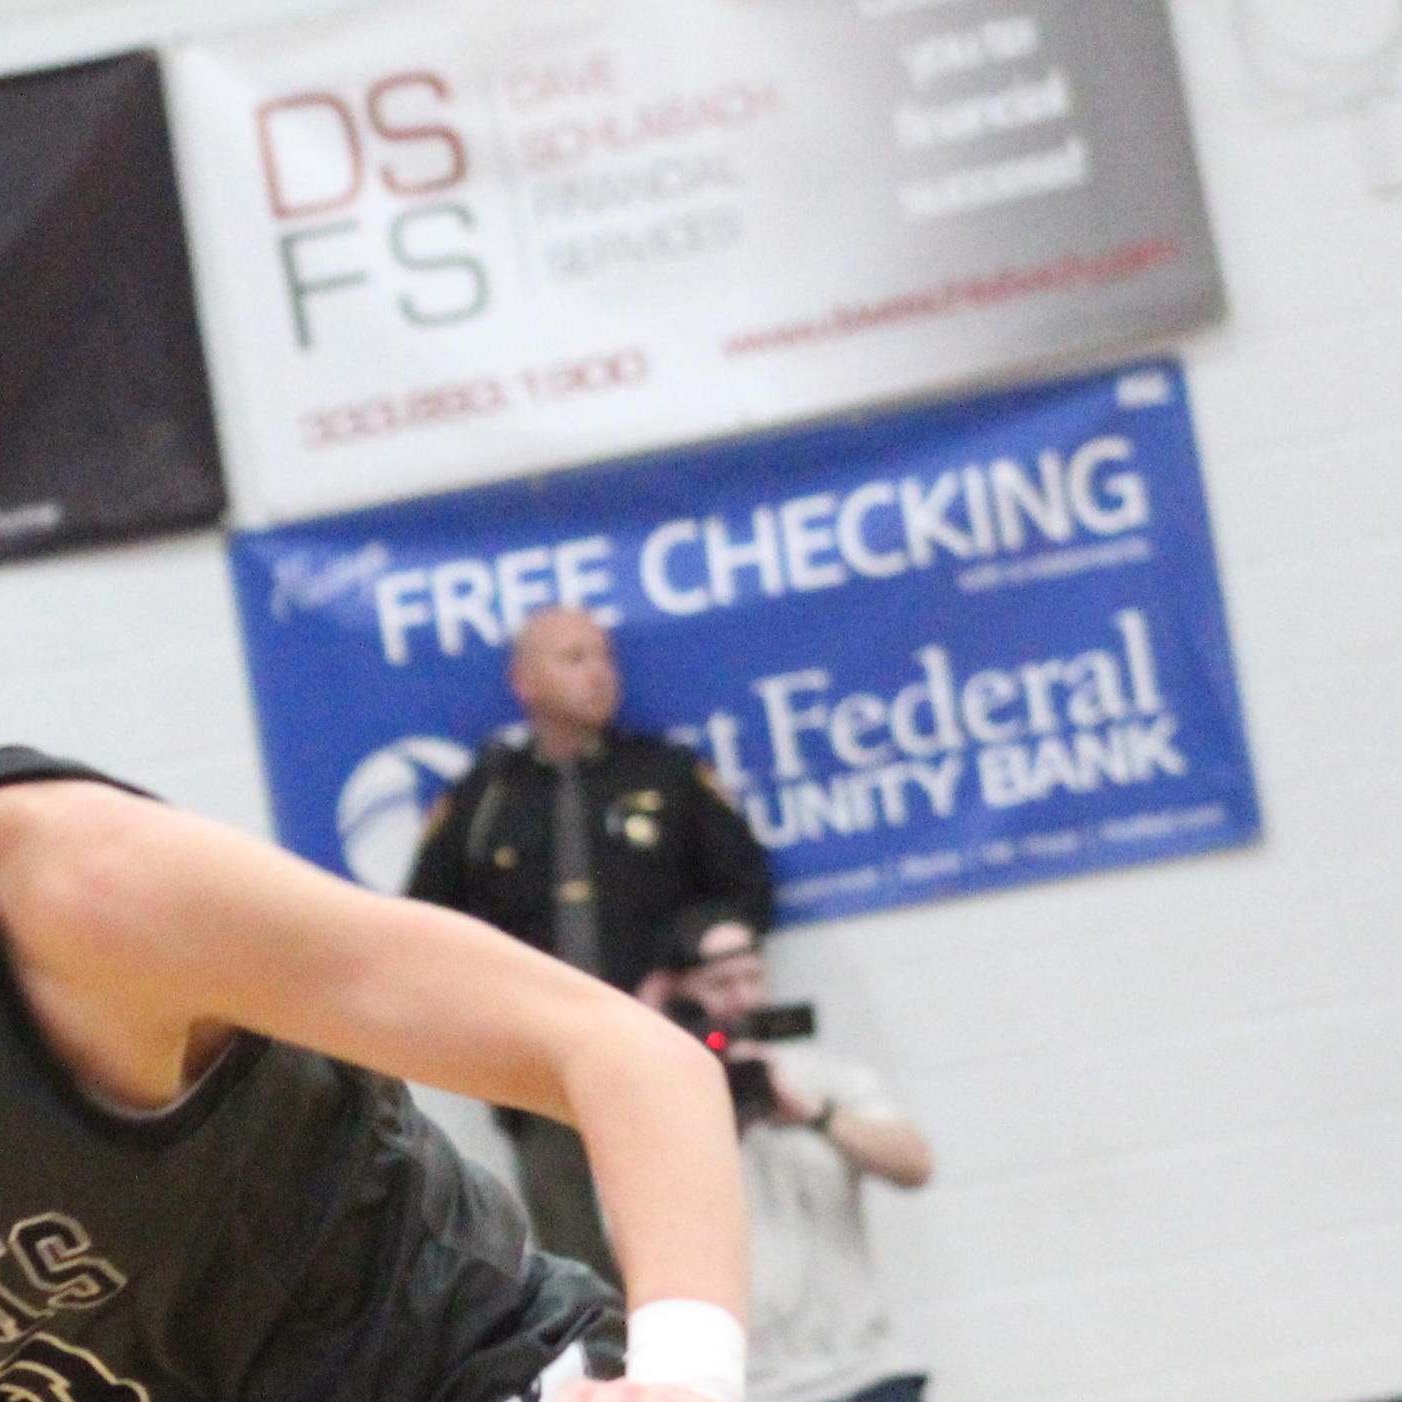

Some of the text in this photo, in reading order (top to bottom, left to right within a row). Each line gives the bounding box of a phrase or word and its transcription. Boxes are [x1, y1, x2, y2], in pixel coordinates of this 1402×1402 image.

[254, 70, 469, 220] DS
[280, 200, 490, 353] FS
[639, 435, 1150, 616] CHECKING
[751, 606, 1162, 783] Federal
[976, 711, 1189, 809] BANK
